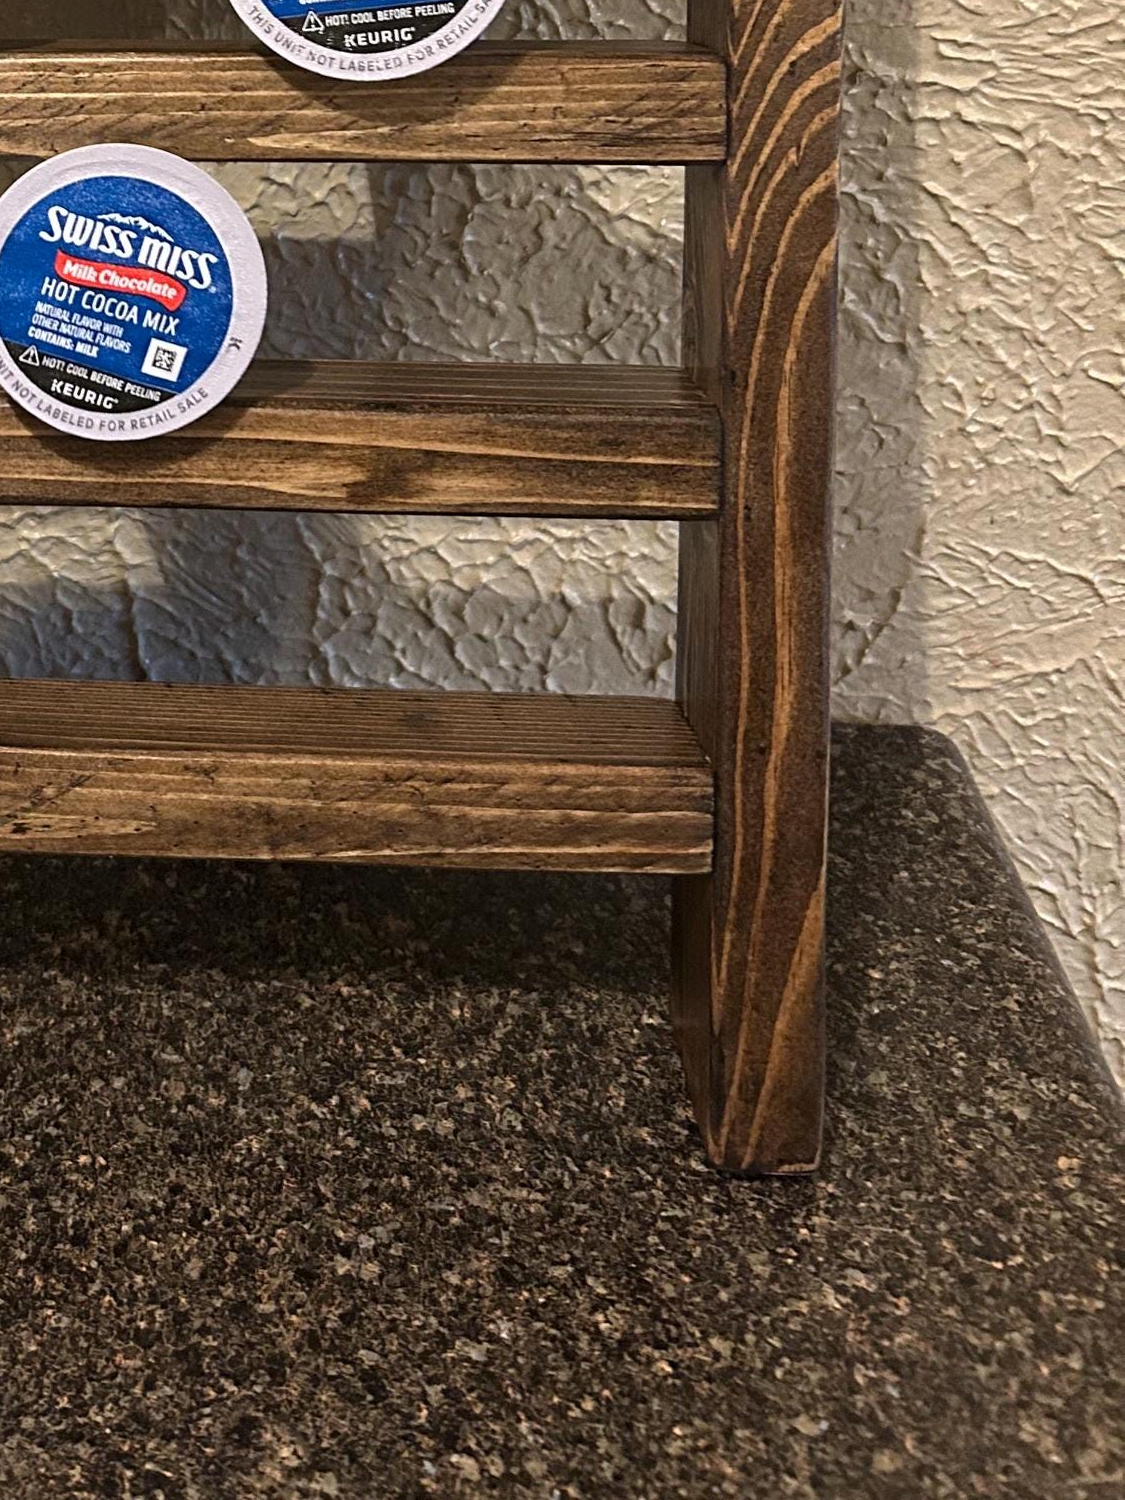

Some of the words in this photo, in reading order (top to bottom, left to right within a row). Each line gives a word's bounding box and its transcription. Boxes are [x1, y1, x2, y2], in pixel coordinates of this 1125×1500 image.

[323, 14, 350, 26] HOT!
[349, 12, 374, 24] COOL
[376, 7, 414, 21] BEFORE
[414, 2, 455, 17] PEELING
[247, 4, 275, 33] THIS
[273, 31, 304, 56] UNIT
[305, 50, 334, 69] NOT
[338, 56, 402, 72] LABELED
[405, 45, 435, 68] FOR
[437, 14, 477, 51] RETAIL
[38, 205, 137, 259] SWISS
[61, 262, 97, 279] Milk
[98, 272, 178, 300] Chocolate
[34, 301, 71, 322] NATURAL
[70, 312, 103, 331] FLAVOR
[100, 321, 124, 338] WITH
[39, 275, 80, 305] HOT
[79, 290, 137, 324] COCOA
[141, 309, 180, 336] MIX
[27, 325, 75, 350] CONTAINS:
[74, 341, 99, 358] MILK
[31, 313, 59, 331] OTHER
[58, 322, 93, 342] NATURAL
[93, 333, 132, 354] FLAVORS
[40, 356, 66, 372] HOT!
[65, 364, 89, 380] COOL
[89, 372, 124, 391] BEFORE
[123, 382, 161, 402] PEELING
[10, 379, 35, 404] NOT
[35, 399, 94, 430] LABELED
[98, 421, 125, 433] FOR
[132, 409, 175, 430] RETAIL
[177, 386, 208, 414] SALE
